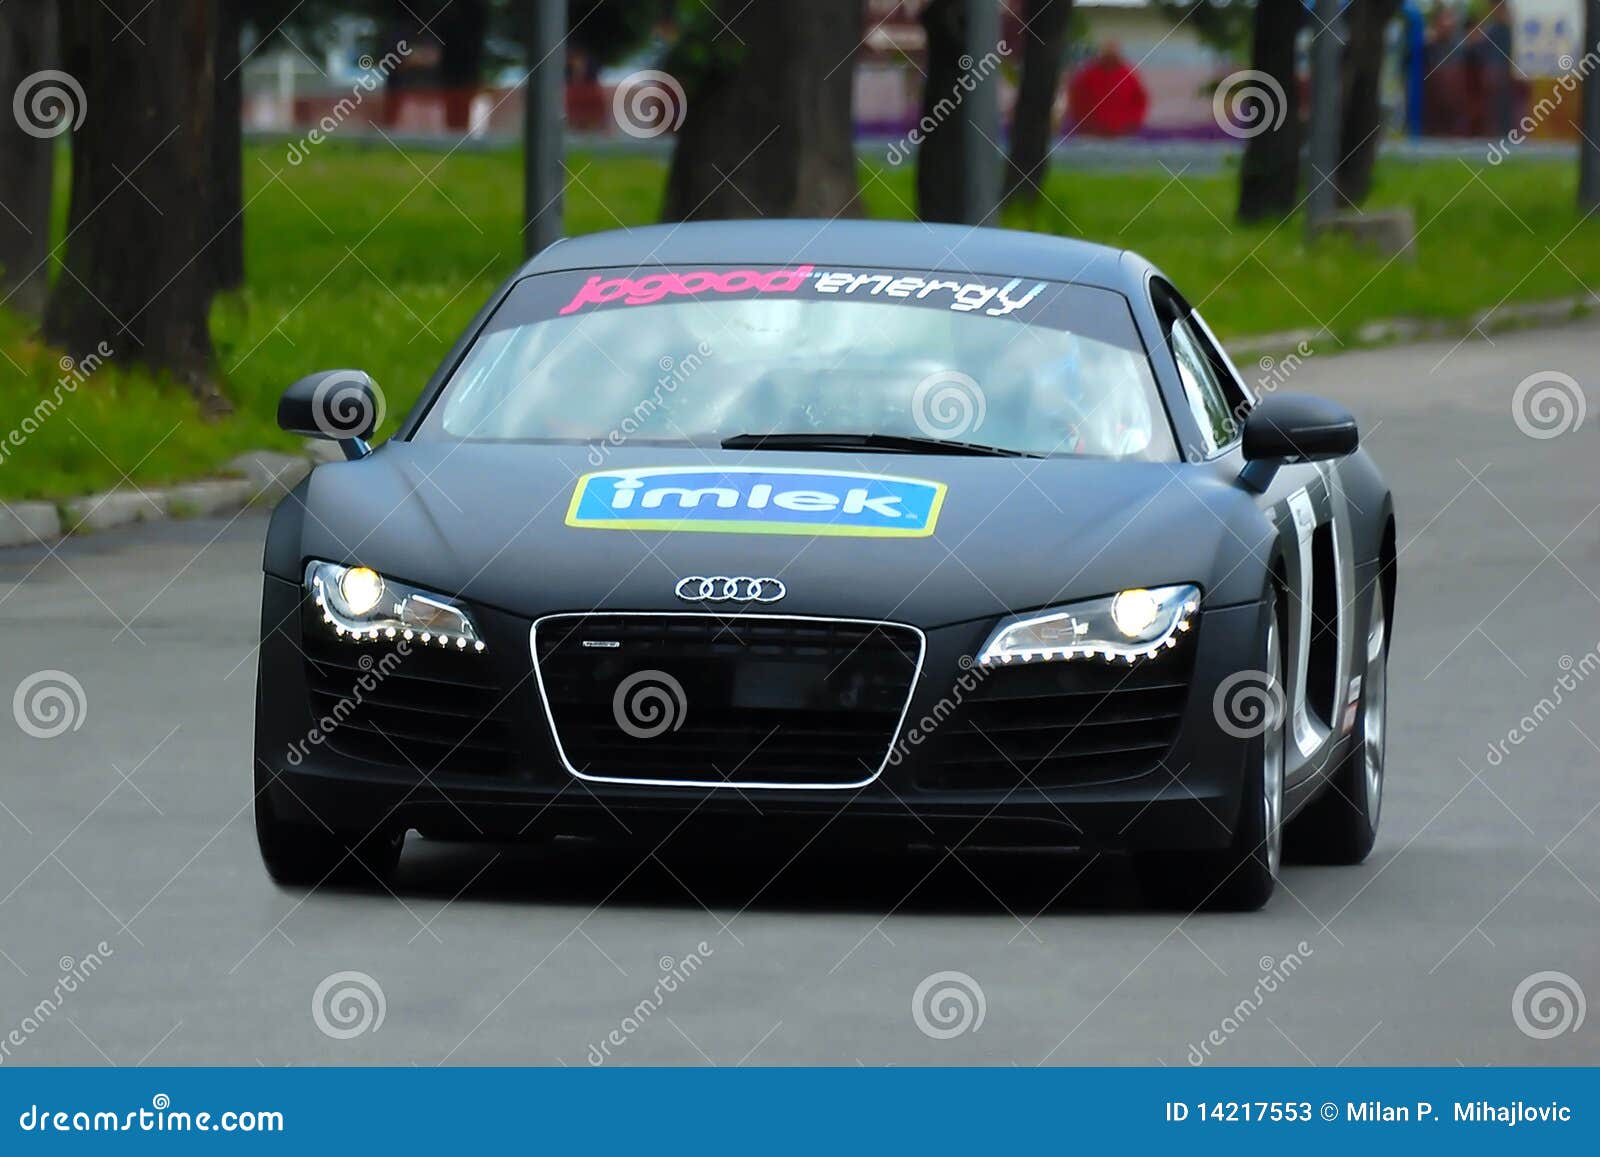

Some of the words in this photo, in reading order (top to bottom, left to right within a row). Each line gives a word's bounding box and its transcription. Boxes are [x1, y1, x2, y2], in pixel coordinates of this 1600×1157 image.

[559, 264, 815, 316] jogood
[815, 271, 1047, 317] energy
[611, 479, 903, 518] imlek
